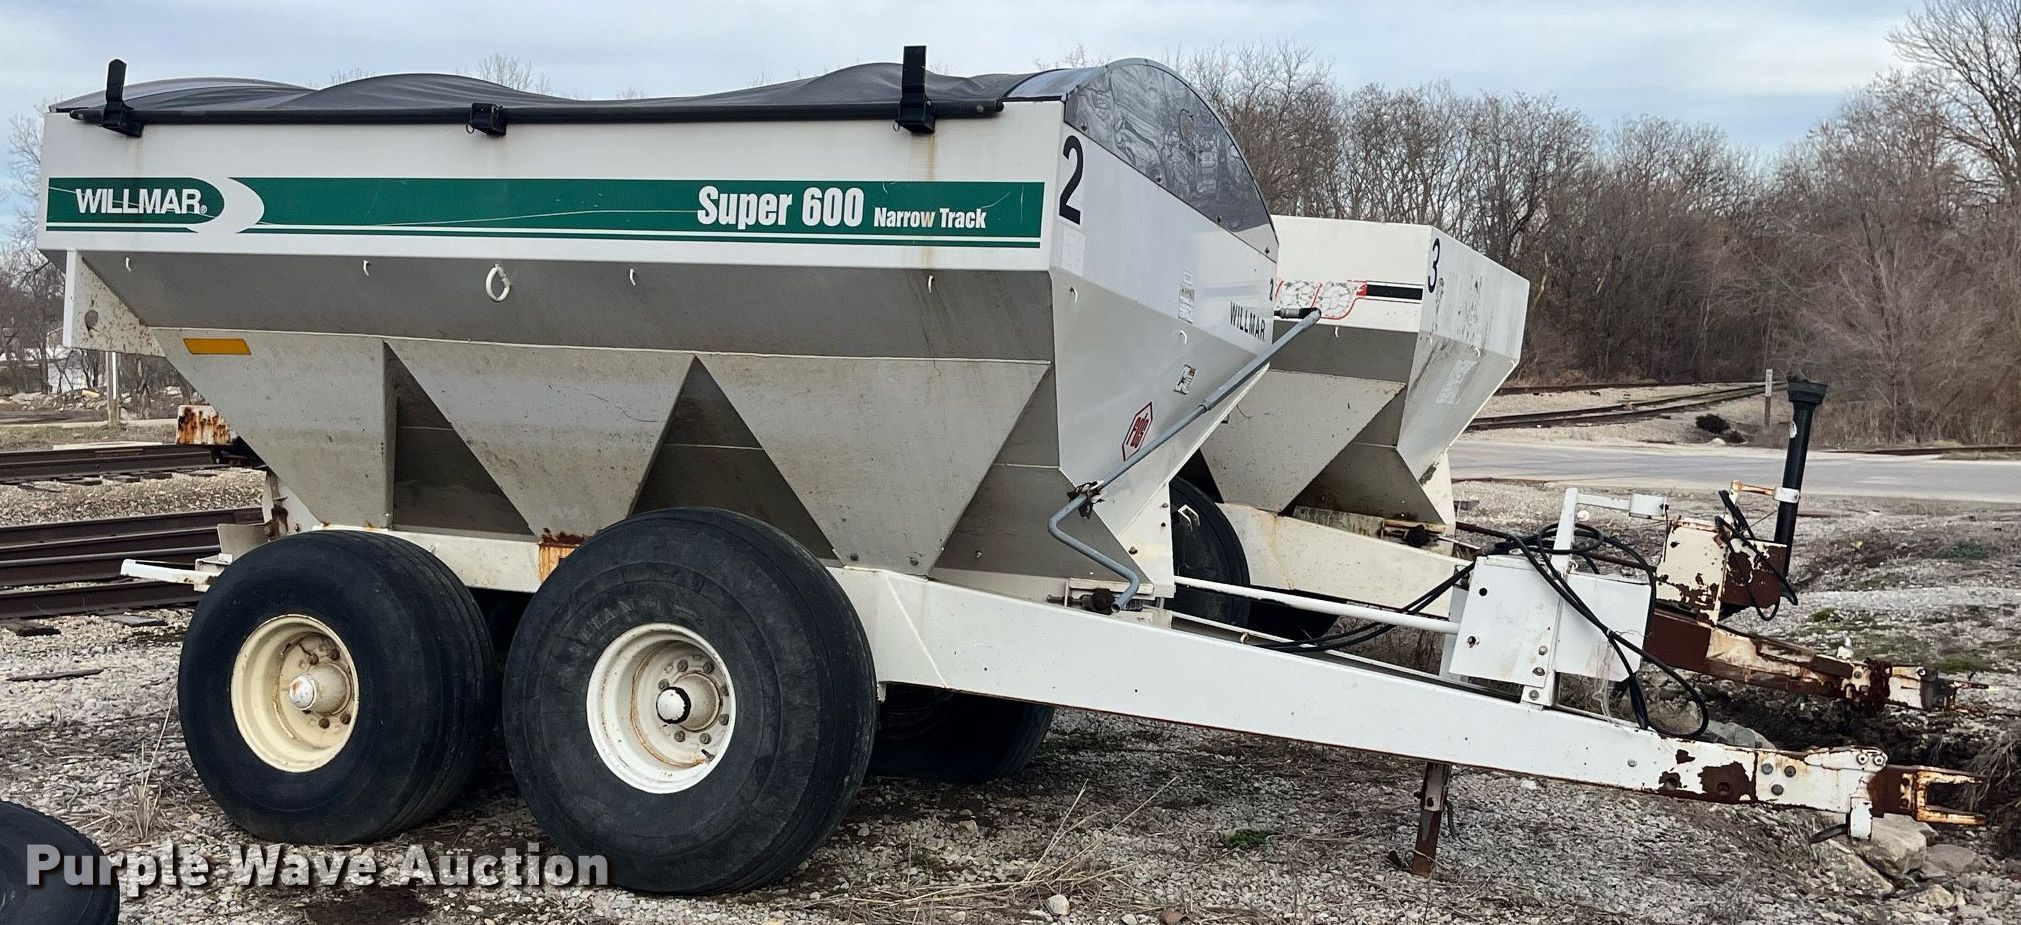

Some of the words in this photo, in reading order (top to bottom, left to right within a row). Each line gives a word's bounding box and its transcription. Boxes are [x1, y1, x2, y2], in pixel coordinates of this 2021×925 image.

[1059, 135, 1084, 225] 2
[697, 185, 793, 230] Super
[801, 187, 865, 227] 600
[873, 207, 936, 228] Narrow
[939, 208, 987, 229] Track
[1428, 238, 1441, 293] 3
[1269, 278, 1275, 302] 2
[1230, 301, 1266, 341] WILLMAR
